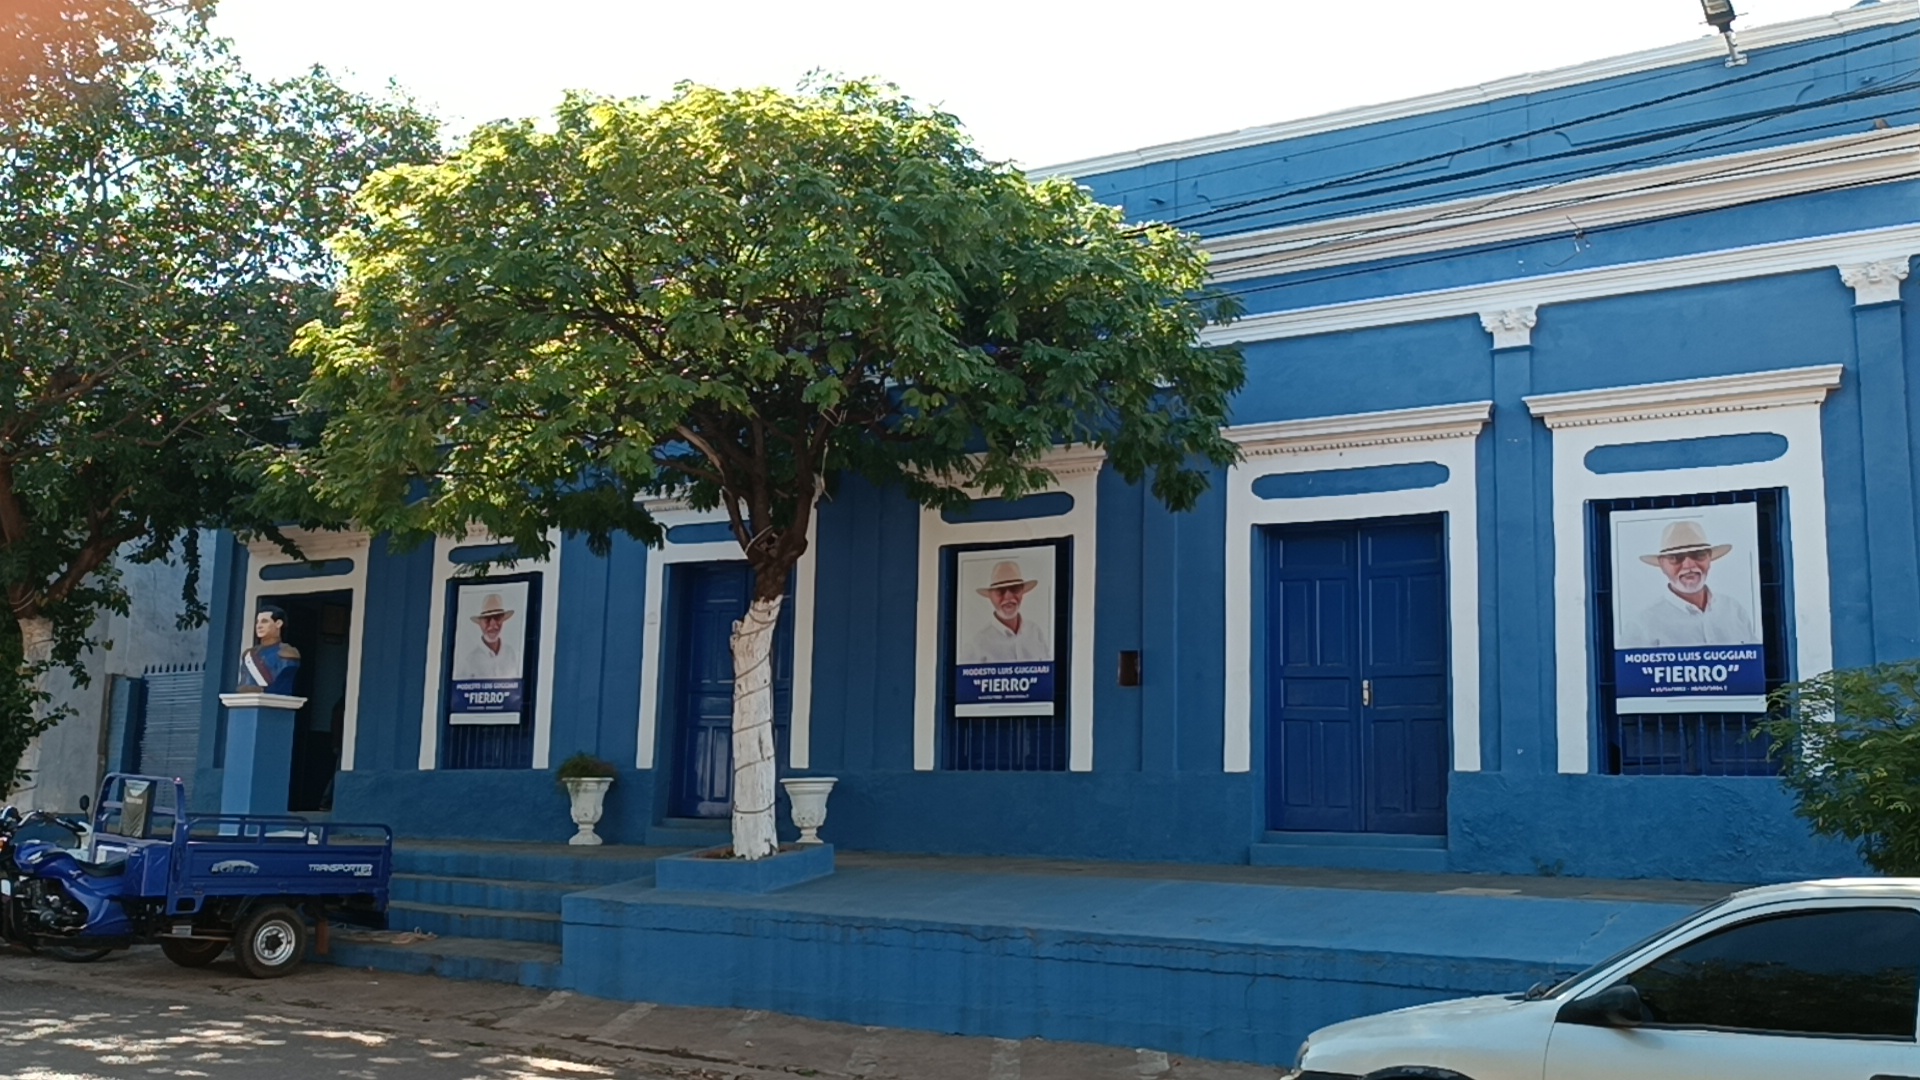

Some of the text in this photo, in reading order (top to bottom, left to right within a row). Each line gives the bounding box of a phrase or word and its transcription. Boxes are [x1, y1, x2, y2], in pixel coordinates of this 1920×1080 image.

[1625, 650, 1757, 663] MODESTO LUIS GUGGIARI
[962, 668, 997, 676] MODESTO
[997, 667, 1013, 675] LUIS
[1641, 664, 1740, 684] "FIERRO"
[973, 677, 1038, 693] "FIERRO"
[308, 863, 373, 873] TRANSPORTER
